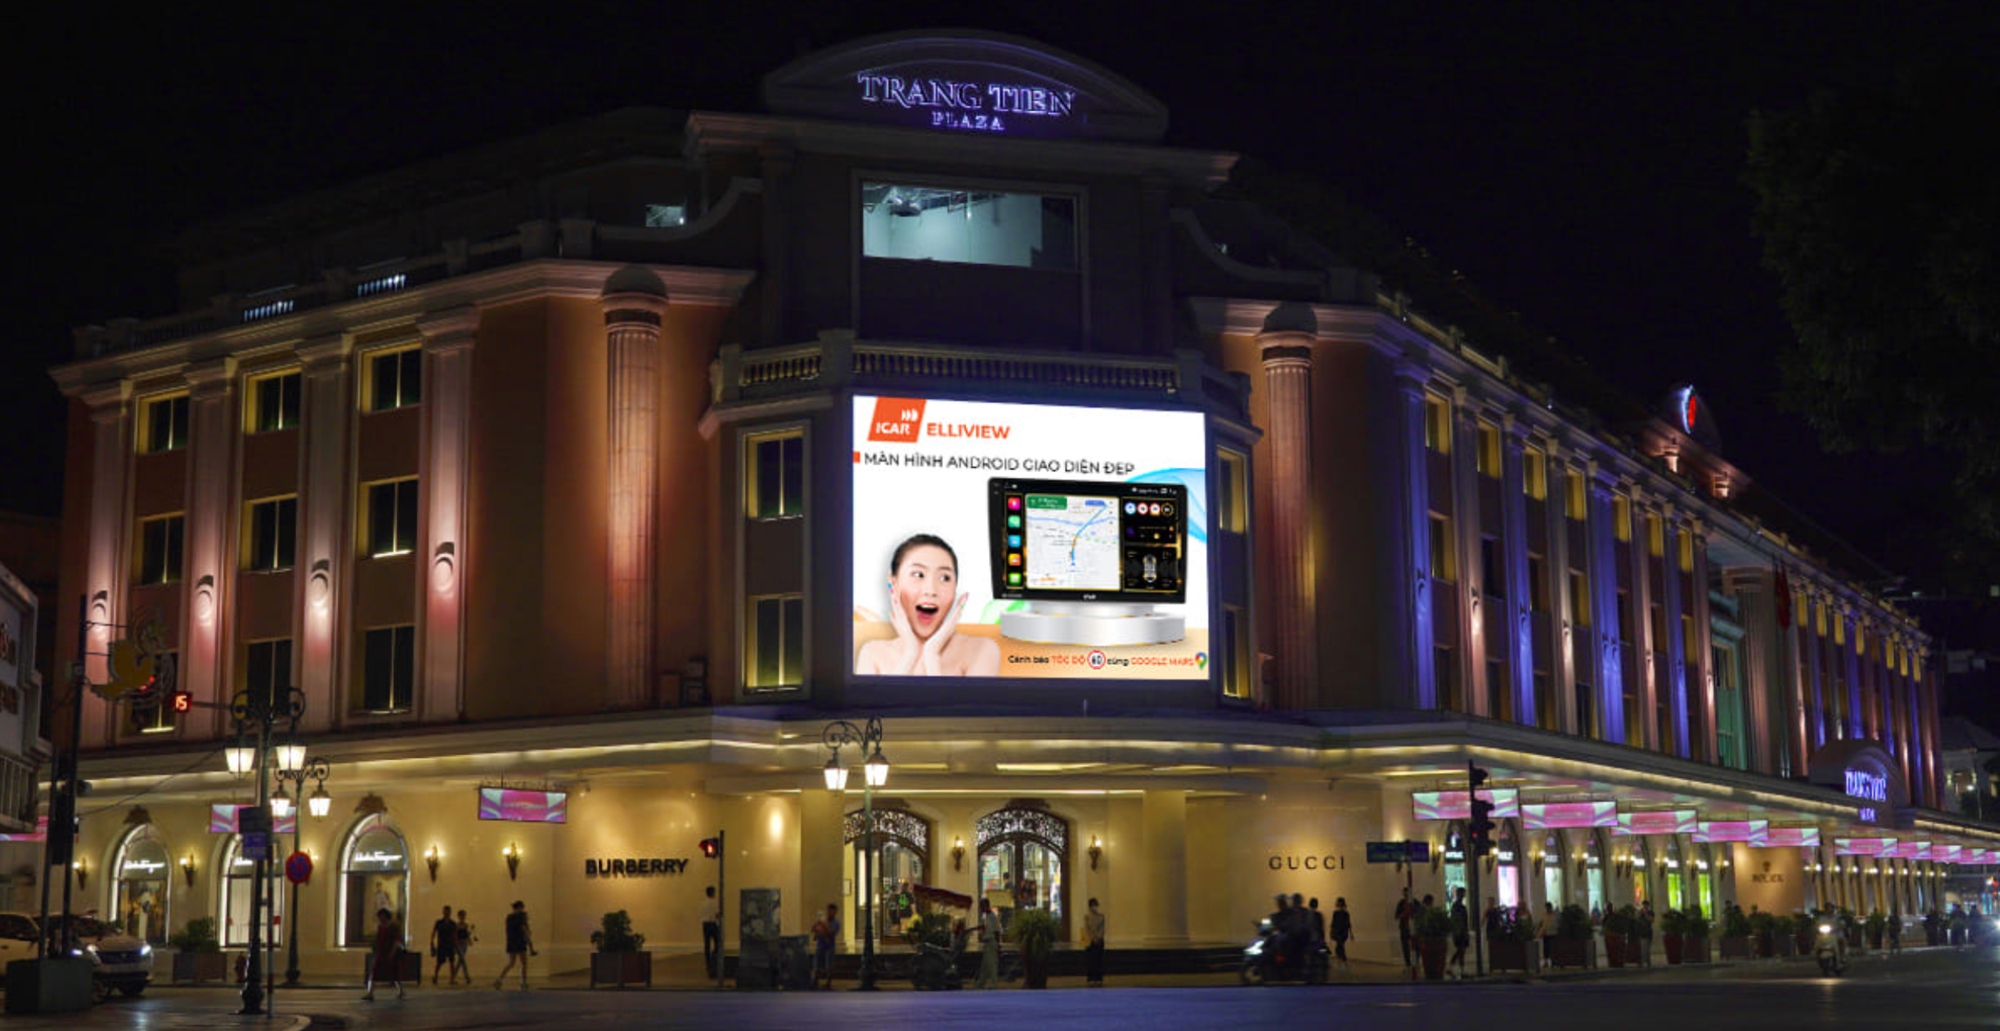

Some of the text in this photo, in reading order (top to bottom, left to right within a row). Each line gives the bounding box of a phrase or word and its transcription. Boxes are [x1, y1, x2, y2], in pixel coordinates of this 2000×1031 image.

[857, 71, 1076, 115] TRANG TIEN
[931, 111, 1004, 130] PLAZA
[875, 422, 910, 435] ICAR
[927, 422, 1010, 439] ELLIVIEW
[946, 455, 1019, 470] ANDROID
[585, 858, 689, 876] BURBERRY
[1268, 856, 1345, 870] GUCCI
